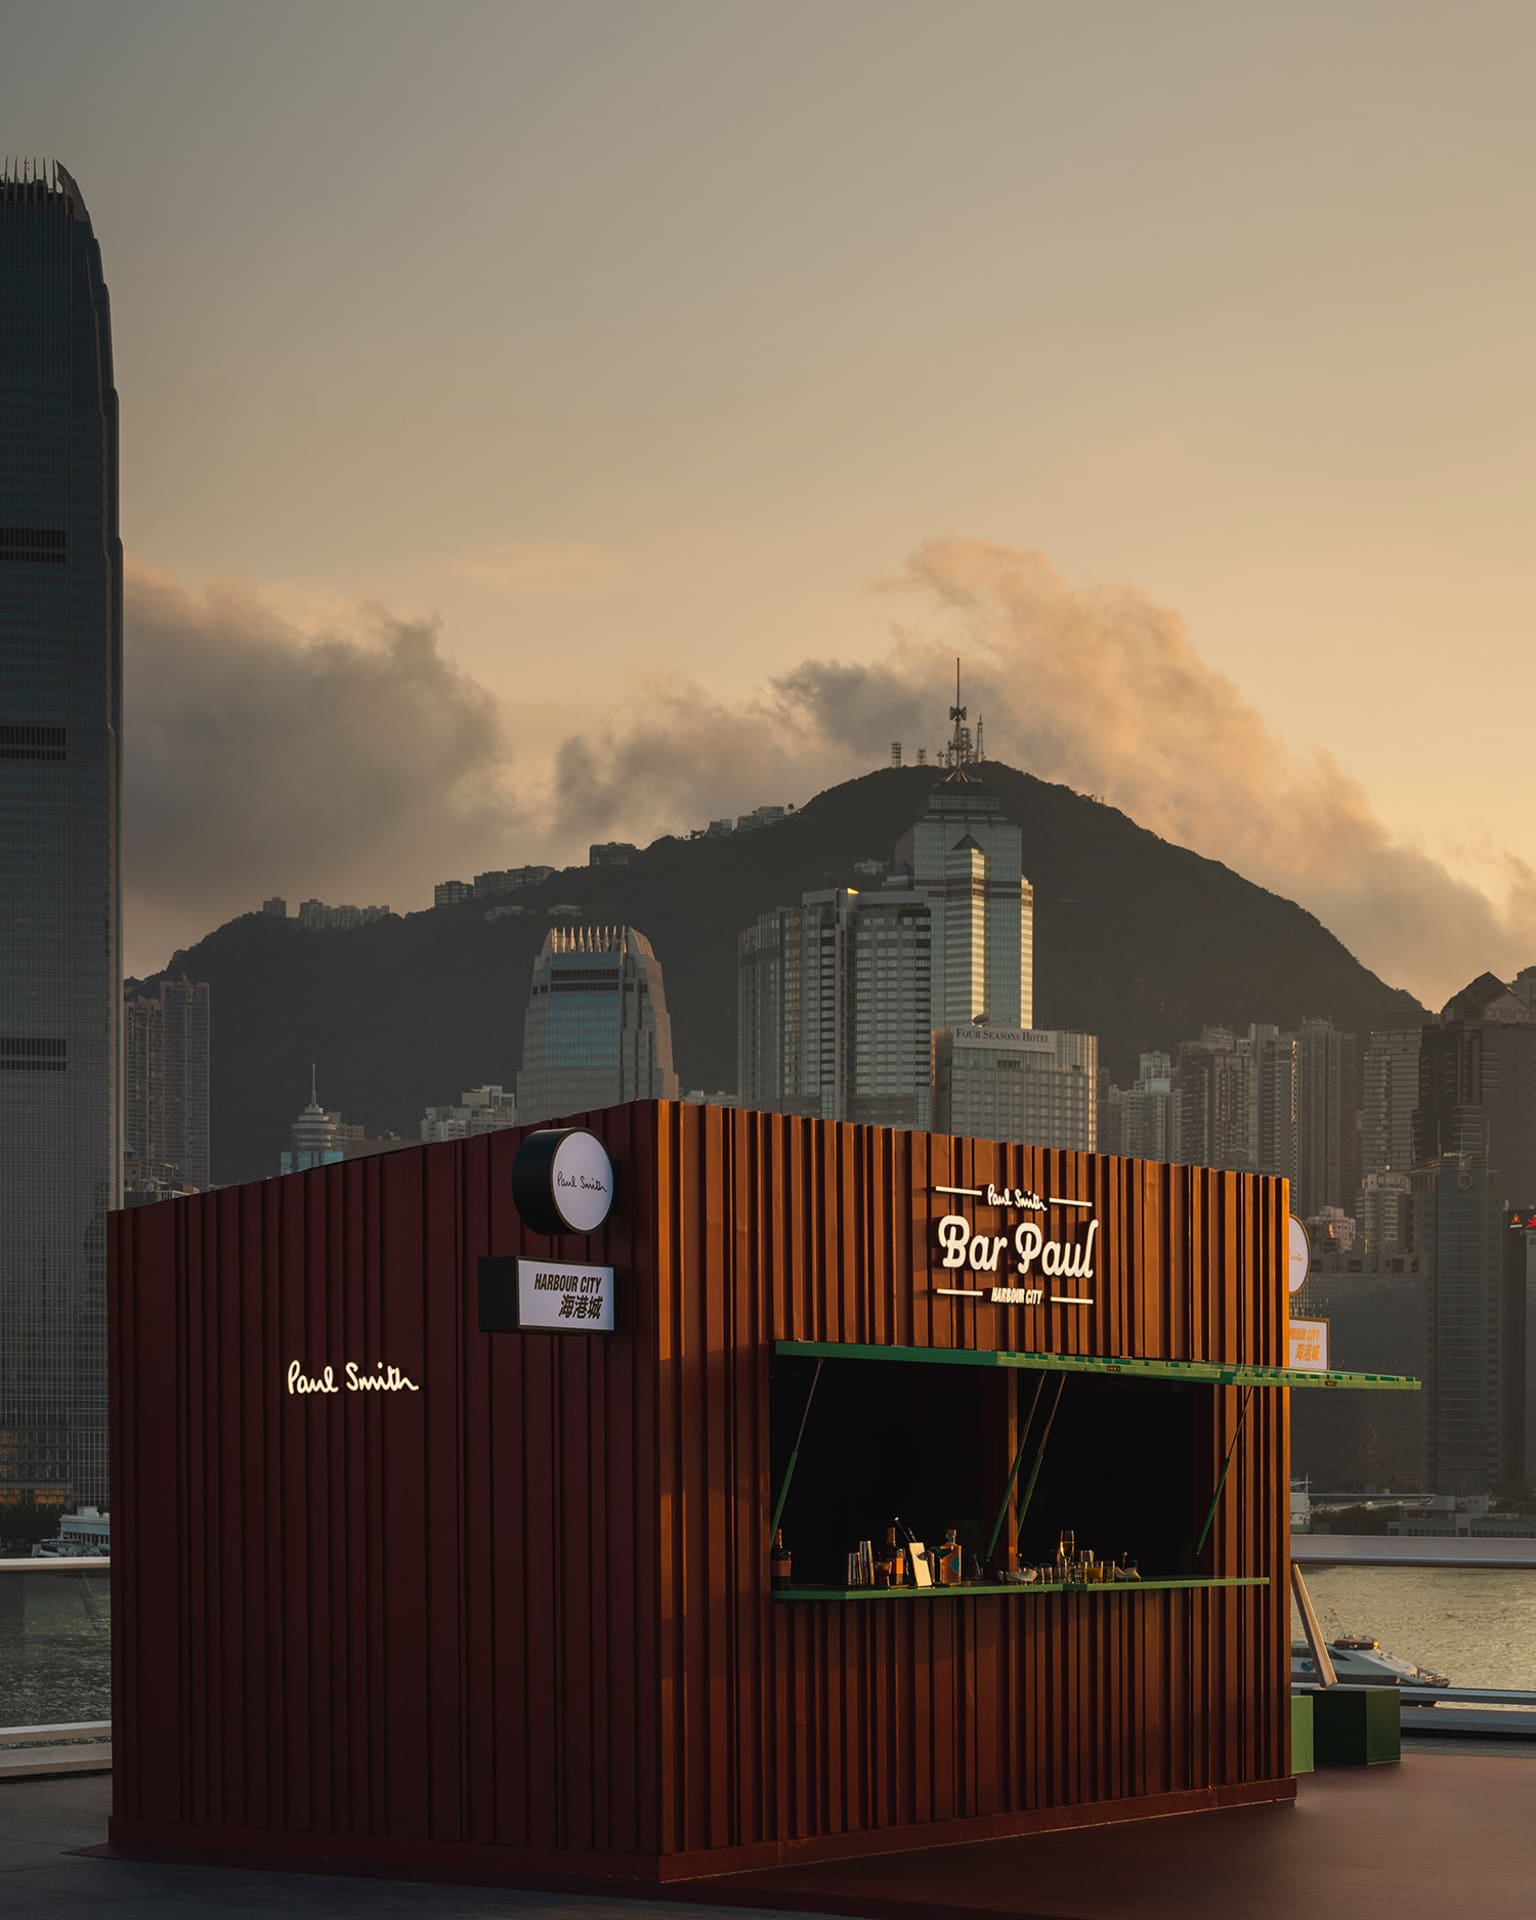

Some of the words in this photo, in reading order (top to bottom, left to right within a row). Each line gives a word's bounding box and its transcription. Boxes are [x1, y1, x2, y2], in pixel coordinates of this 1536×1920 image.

[956, 1028, 980, 1040] FOUR
[983, 1029, 1020, 1041] SEASONS
[557, 1171, 577, 1188] Paul
[580, 1175, 608, 1192] Smith
[987, 1183, 1012, 1206] Paul
[1014, 1188, 1048, 1211] Smith
[938, 1215, 1008, 1272] Bar
[1015, 1219, 1099, 1279] Paul
[534, 1273, 578, 1293] HARBOUR
[580, 1277, 602, 1294] CITY
[558, 1295, 603, 1319] 海港城
[990, 1287, 1025, 1304] HARBOUR
[1025, 1289, 1043, 1305] CITY
[288, 1360, 339, 1394] Paul
[345, 1361, 419, 1392] Smith
